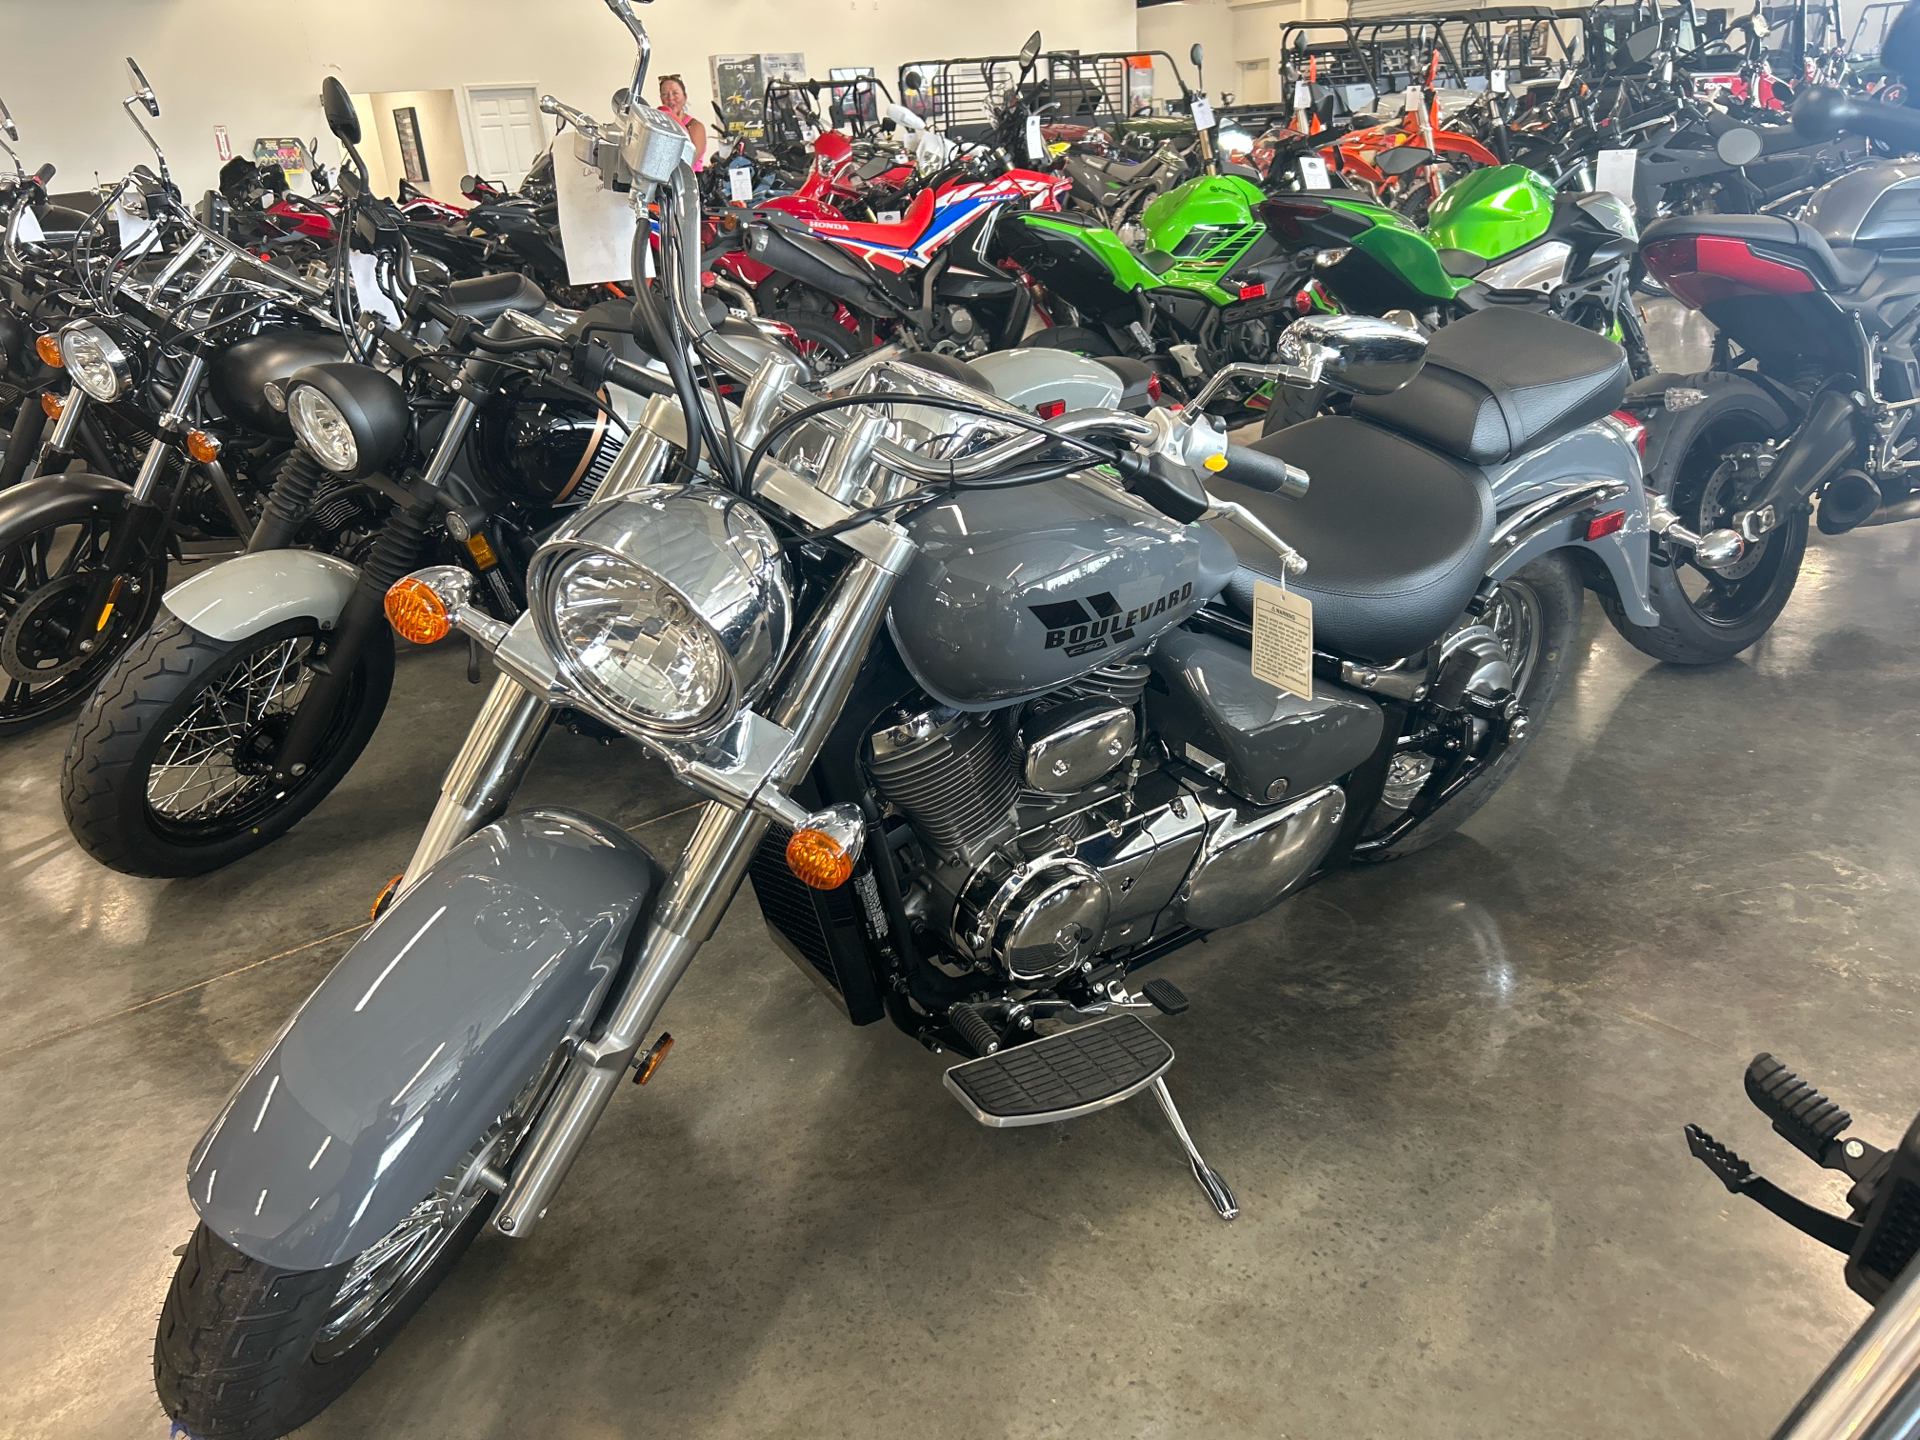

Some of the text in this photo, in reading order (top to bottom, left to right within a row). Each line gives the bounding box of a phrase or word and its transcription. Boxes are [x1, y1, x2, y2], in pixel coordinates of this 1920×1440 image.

[978, 193, 1019, 203] RALLY
[809, 220, 850, 231] HONDA
[1044, 581, 1192, 649] BOULEVARD
[1276, 607, 1296, 620] WARNING
[1068, 639, 1105, 655] C50
